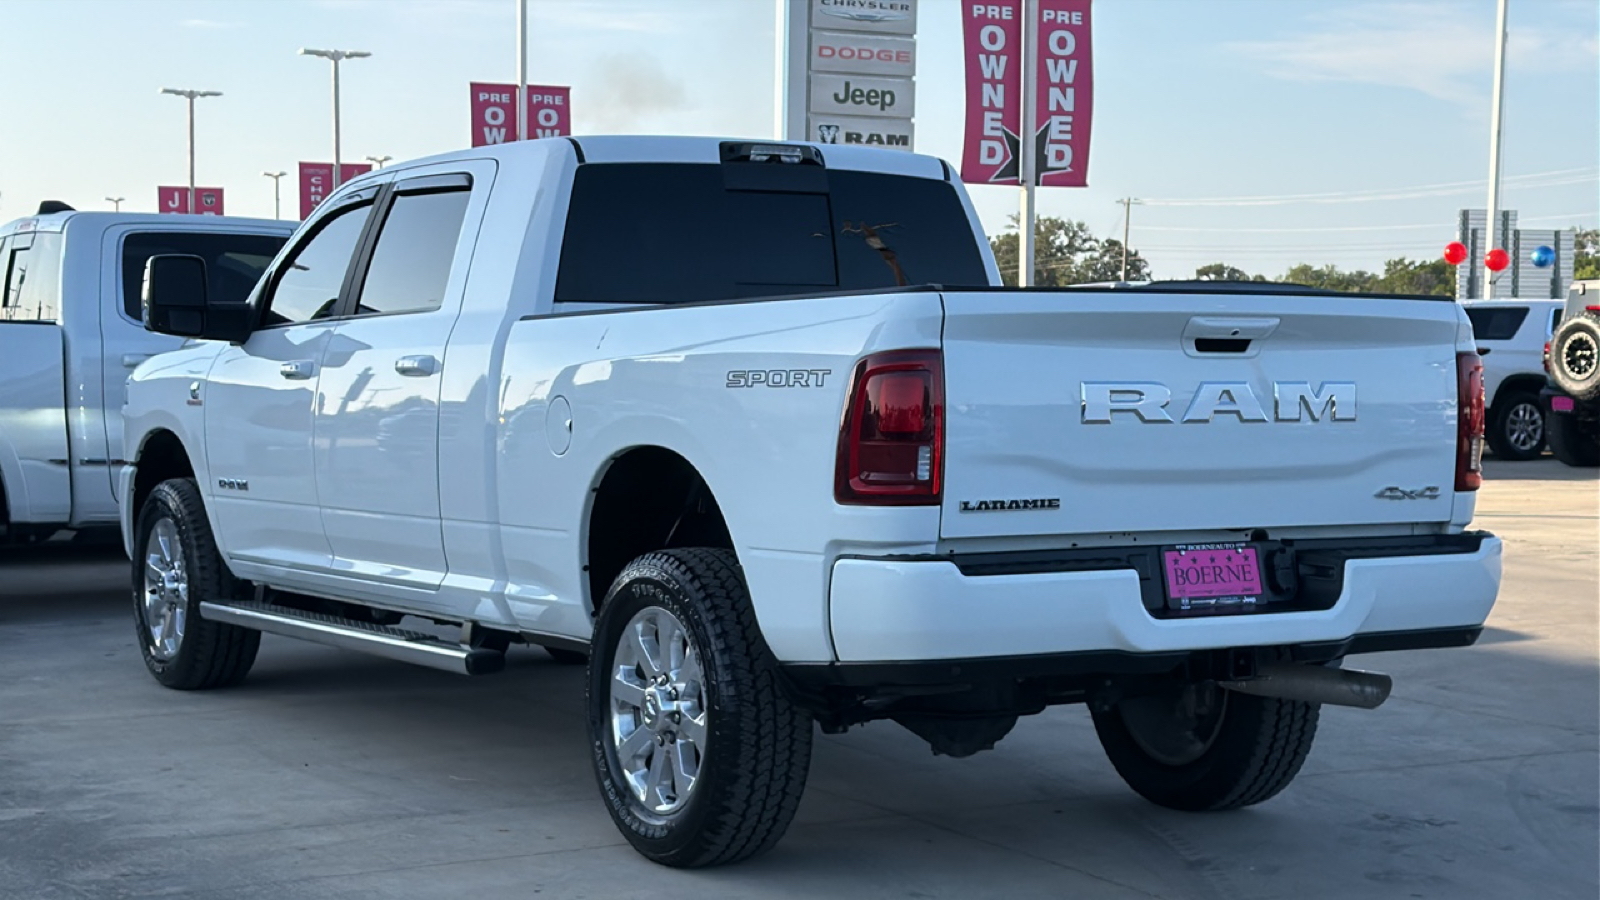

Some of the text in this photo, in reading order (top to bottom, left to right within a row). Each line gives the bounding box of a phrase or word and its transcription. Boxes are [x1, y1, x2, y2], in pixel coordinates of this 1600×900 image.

[820, 0, 910, 11] CHRYSLER
[972, 5, 1013, 20] PRE
[1043, 9, 1083, 25] PRE
[818, 45, 911, 63] DODGE
[479, 92, 510, 103] PRE
[532, 94, 564, 105] PRE
[833, 81, 896, 111] Jeep
[978, 25, 1008, 165] OWNED
[1046, 29, 1078, 168] OWNED
[845, 131, 909, 146] RAM
[725, 369, 831, 388] SPORT
[1080, 381, 1357, 424] RAM
[960, 498, 1060, 512] LARAMIE
[1174, 564, 1254, 586] BOERNE
